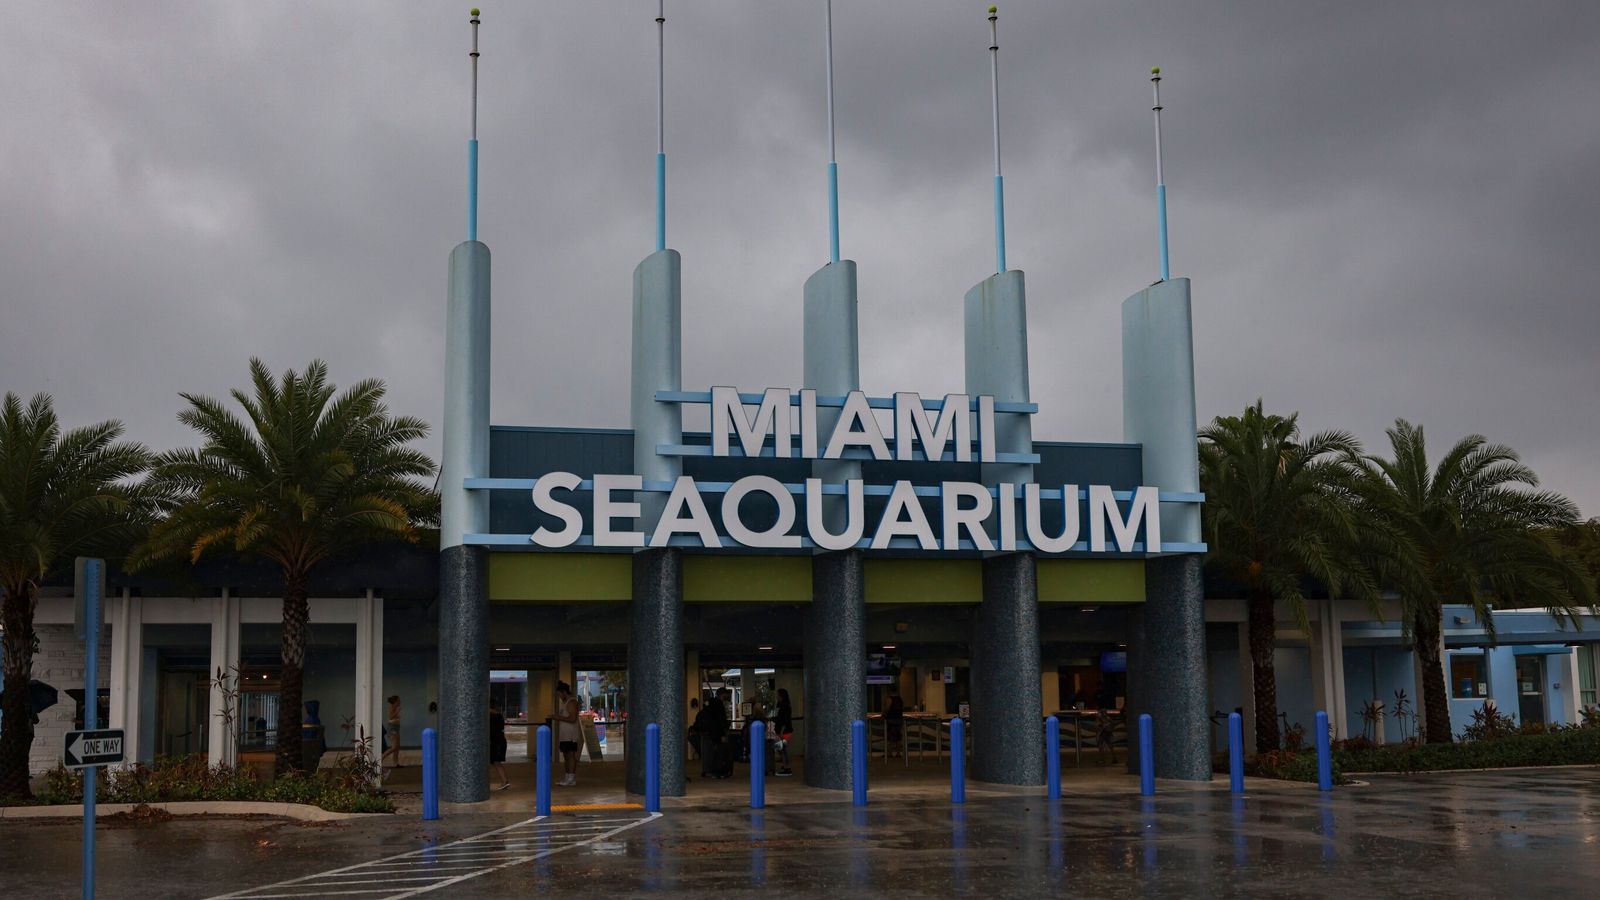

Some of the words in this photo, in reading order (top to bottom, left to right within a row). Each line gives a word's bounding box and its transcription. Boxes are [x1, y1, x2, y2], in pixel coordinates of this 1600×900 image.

[711, 386, 996, 463] MIAMI
[529, 471, 1161, 553] SEAQUARIUM
[84, 741, 101, 755] ONE
[103, 739, 120, 753] WAY
